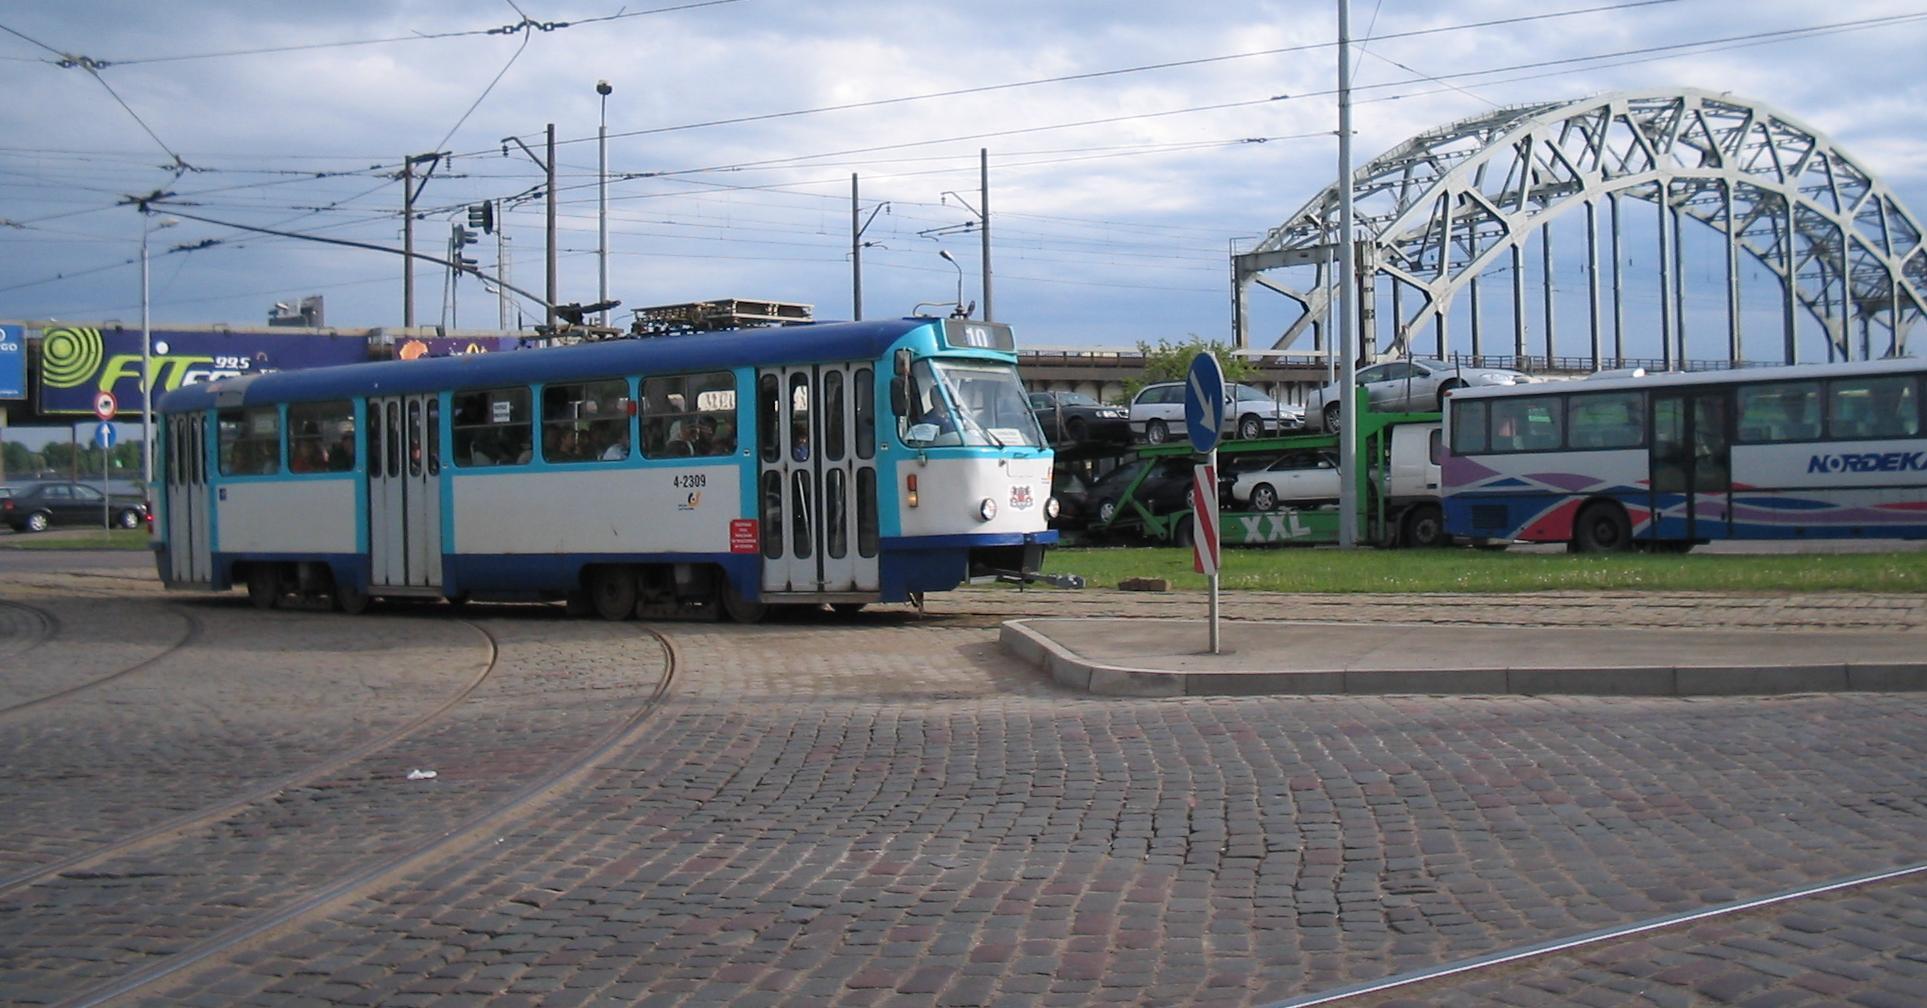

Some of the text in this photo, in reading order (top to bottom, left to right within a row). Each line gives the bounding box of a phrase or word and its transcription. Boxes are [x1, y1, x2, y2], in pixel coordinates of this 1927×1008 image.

[965, 327, 988, 347] 10
[673, 474, 706, 488] 4-2309
[1240, 515, 1312, 543] XXL
